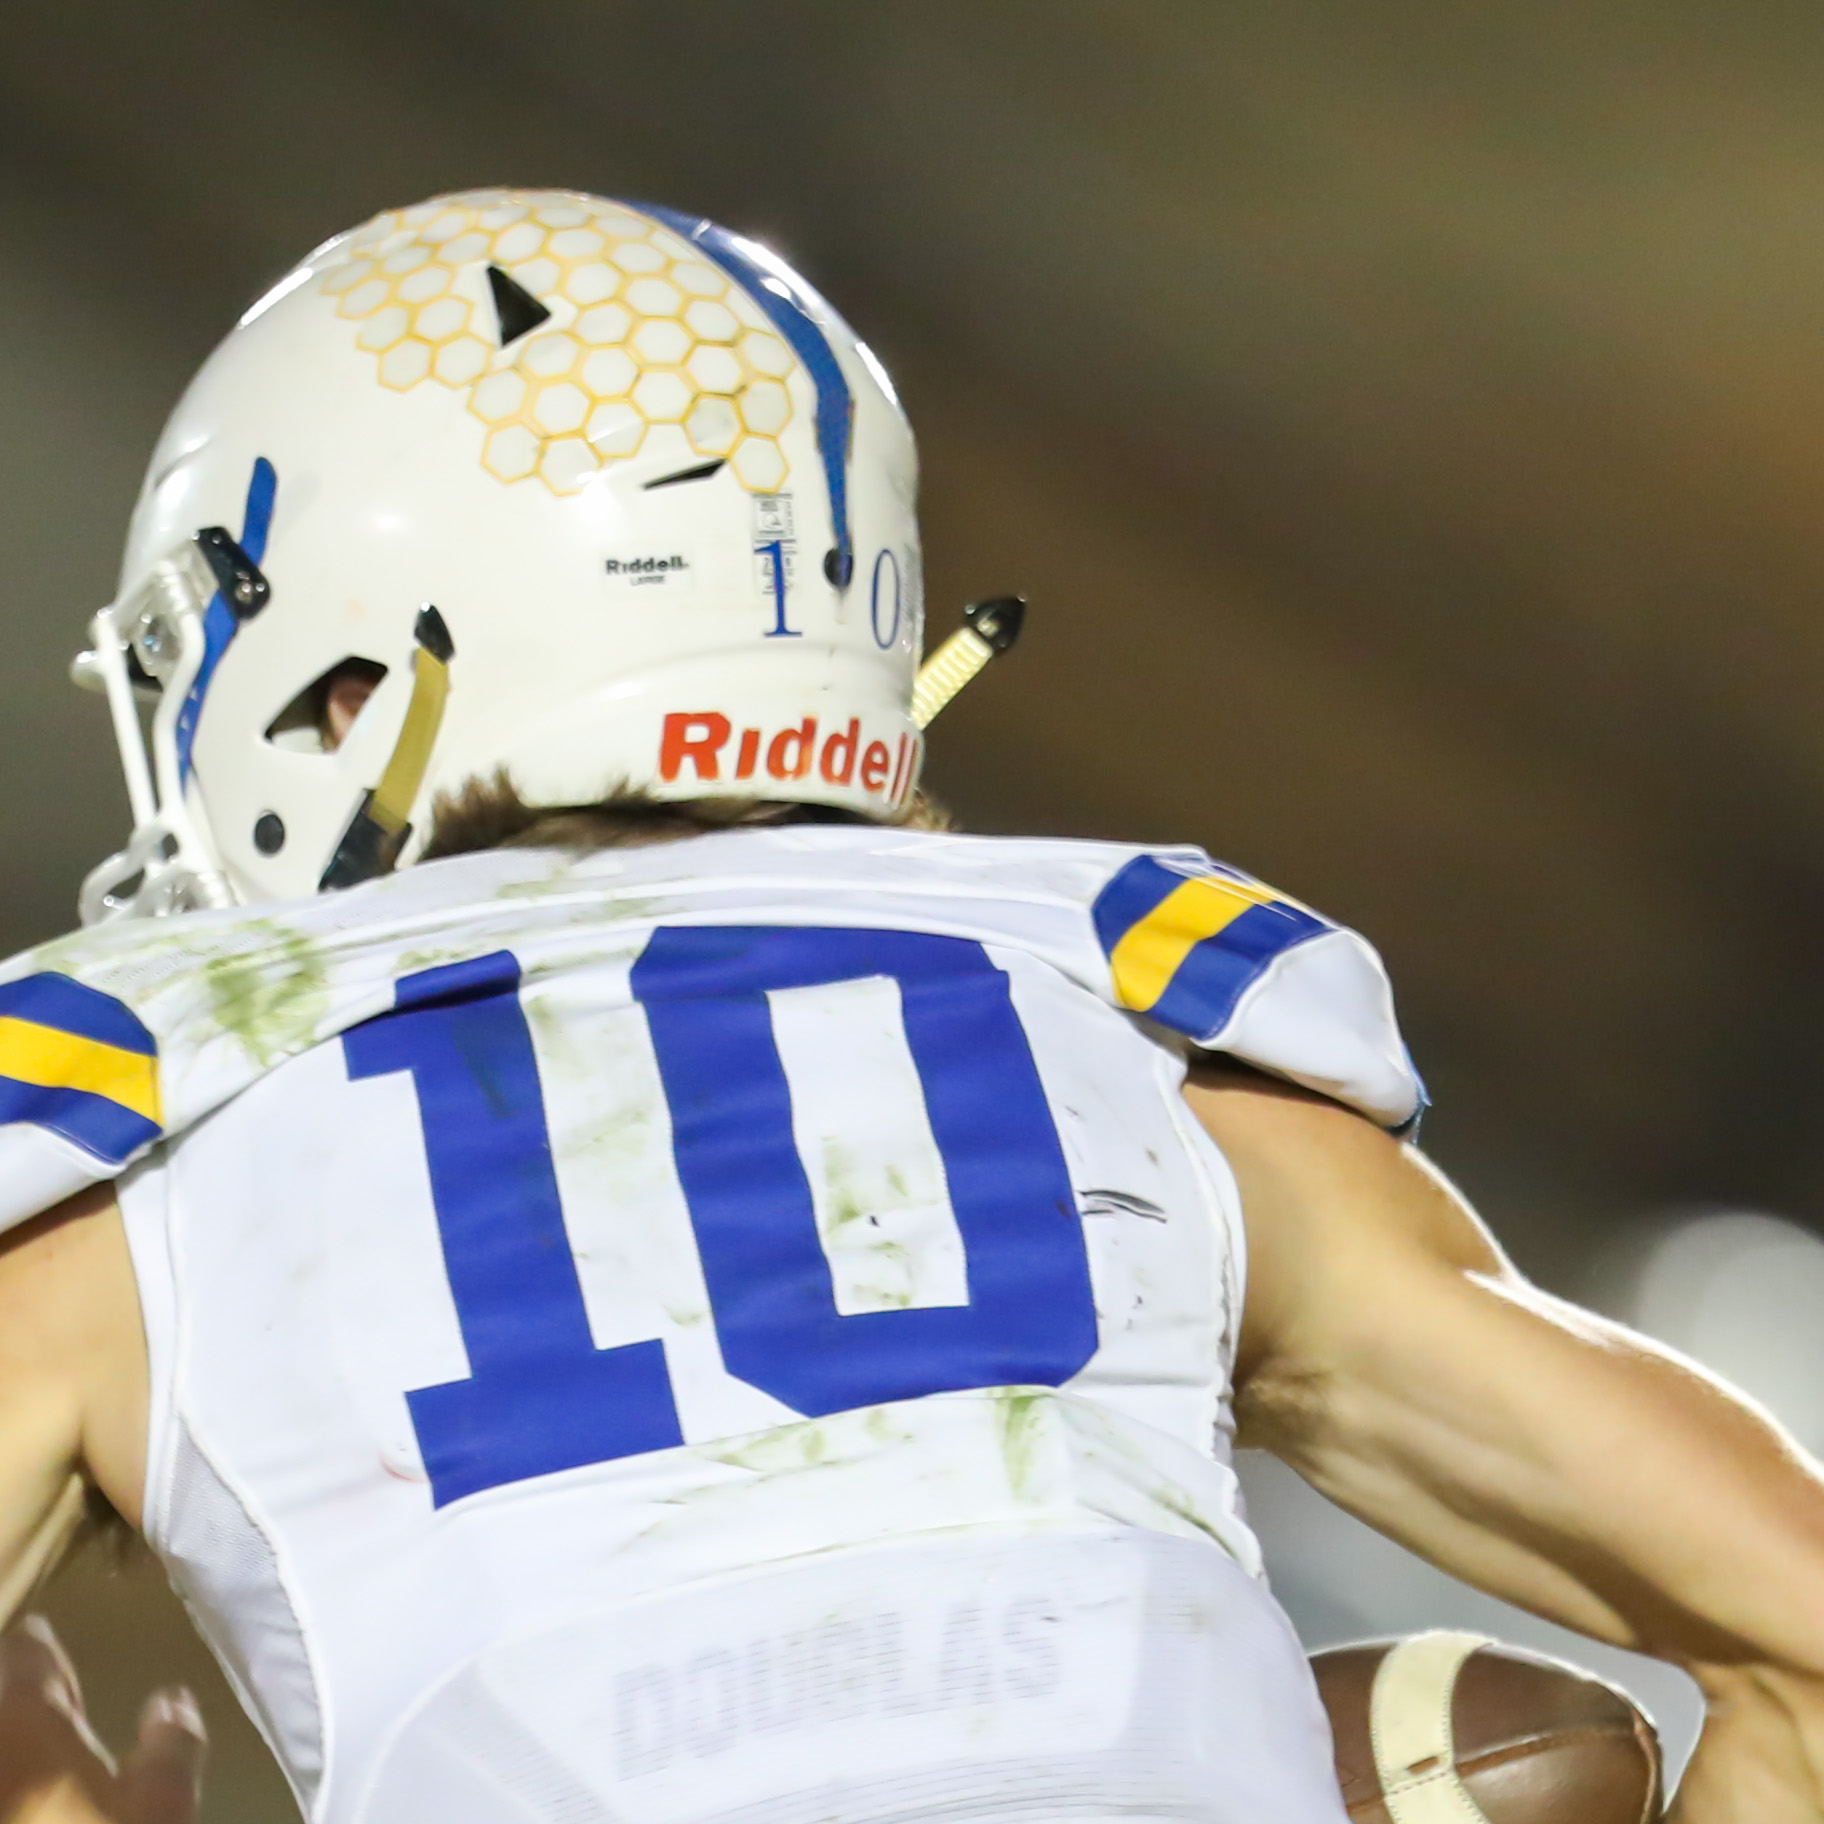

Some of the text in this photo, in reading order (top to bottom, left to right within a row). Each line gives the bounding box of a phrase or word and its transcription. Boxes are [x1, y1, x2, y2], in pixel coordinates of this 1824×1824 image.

[605, 555, 687, 575] Riddell
[659, 711, 919, 804] Riddell
[341, 925, 1099, 1511] 10
[613, 1591, 1064, 1783] DOUGLAS
